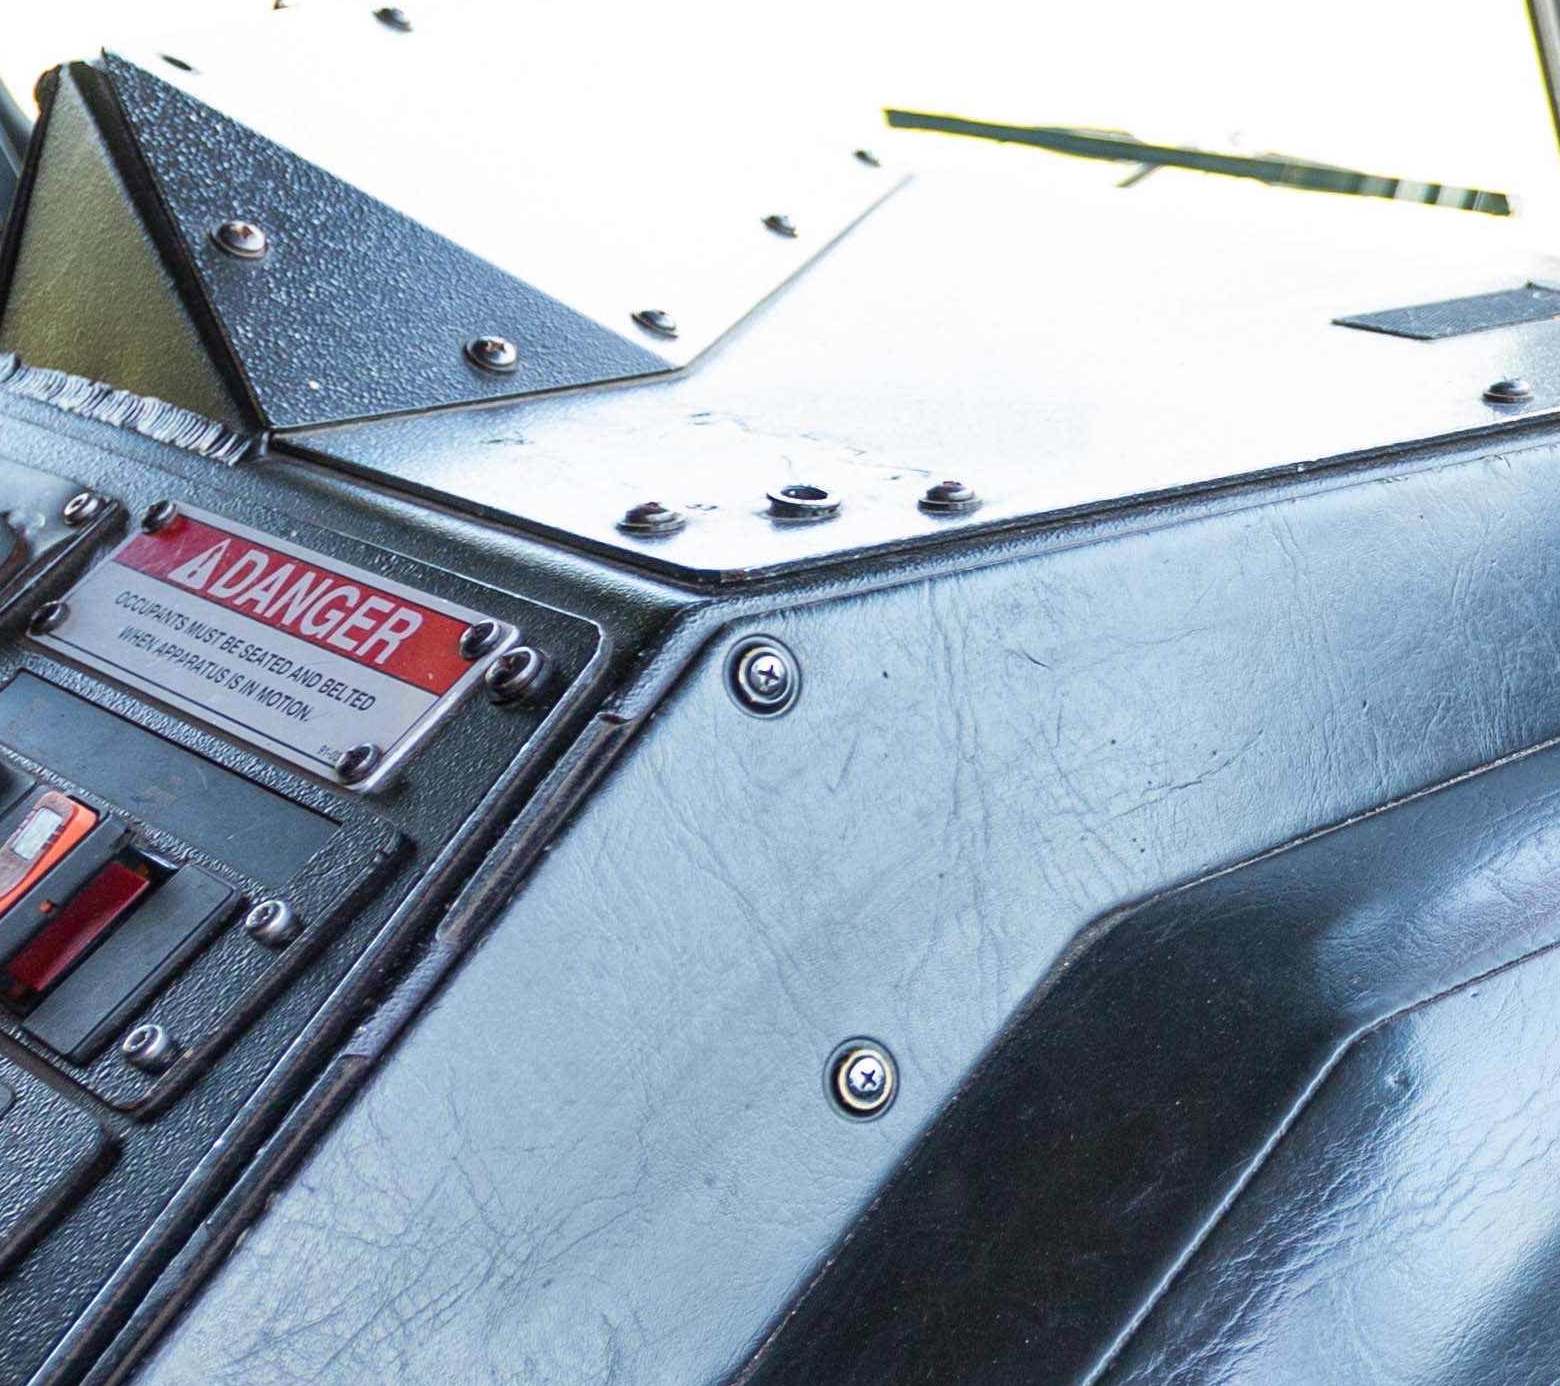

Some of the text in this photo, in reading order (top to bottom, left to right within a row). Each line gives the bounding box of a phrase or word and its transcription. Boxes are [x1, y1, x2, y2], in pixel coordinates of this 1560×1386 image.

[111, 589, 378, 713] OCCUPANTS MUST BE SEATED AND BELTED
[205, 547, 429, 667] DANGER
[115, 624, 319, 724] WHEN APPARATUS IS IN MOTION.
